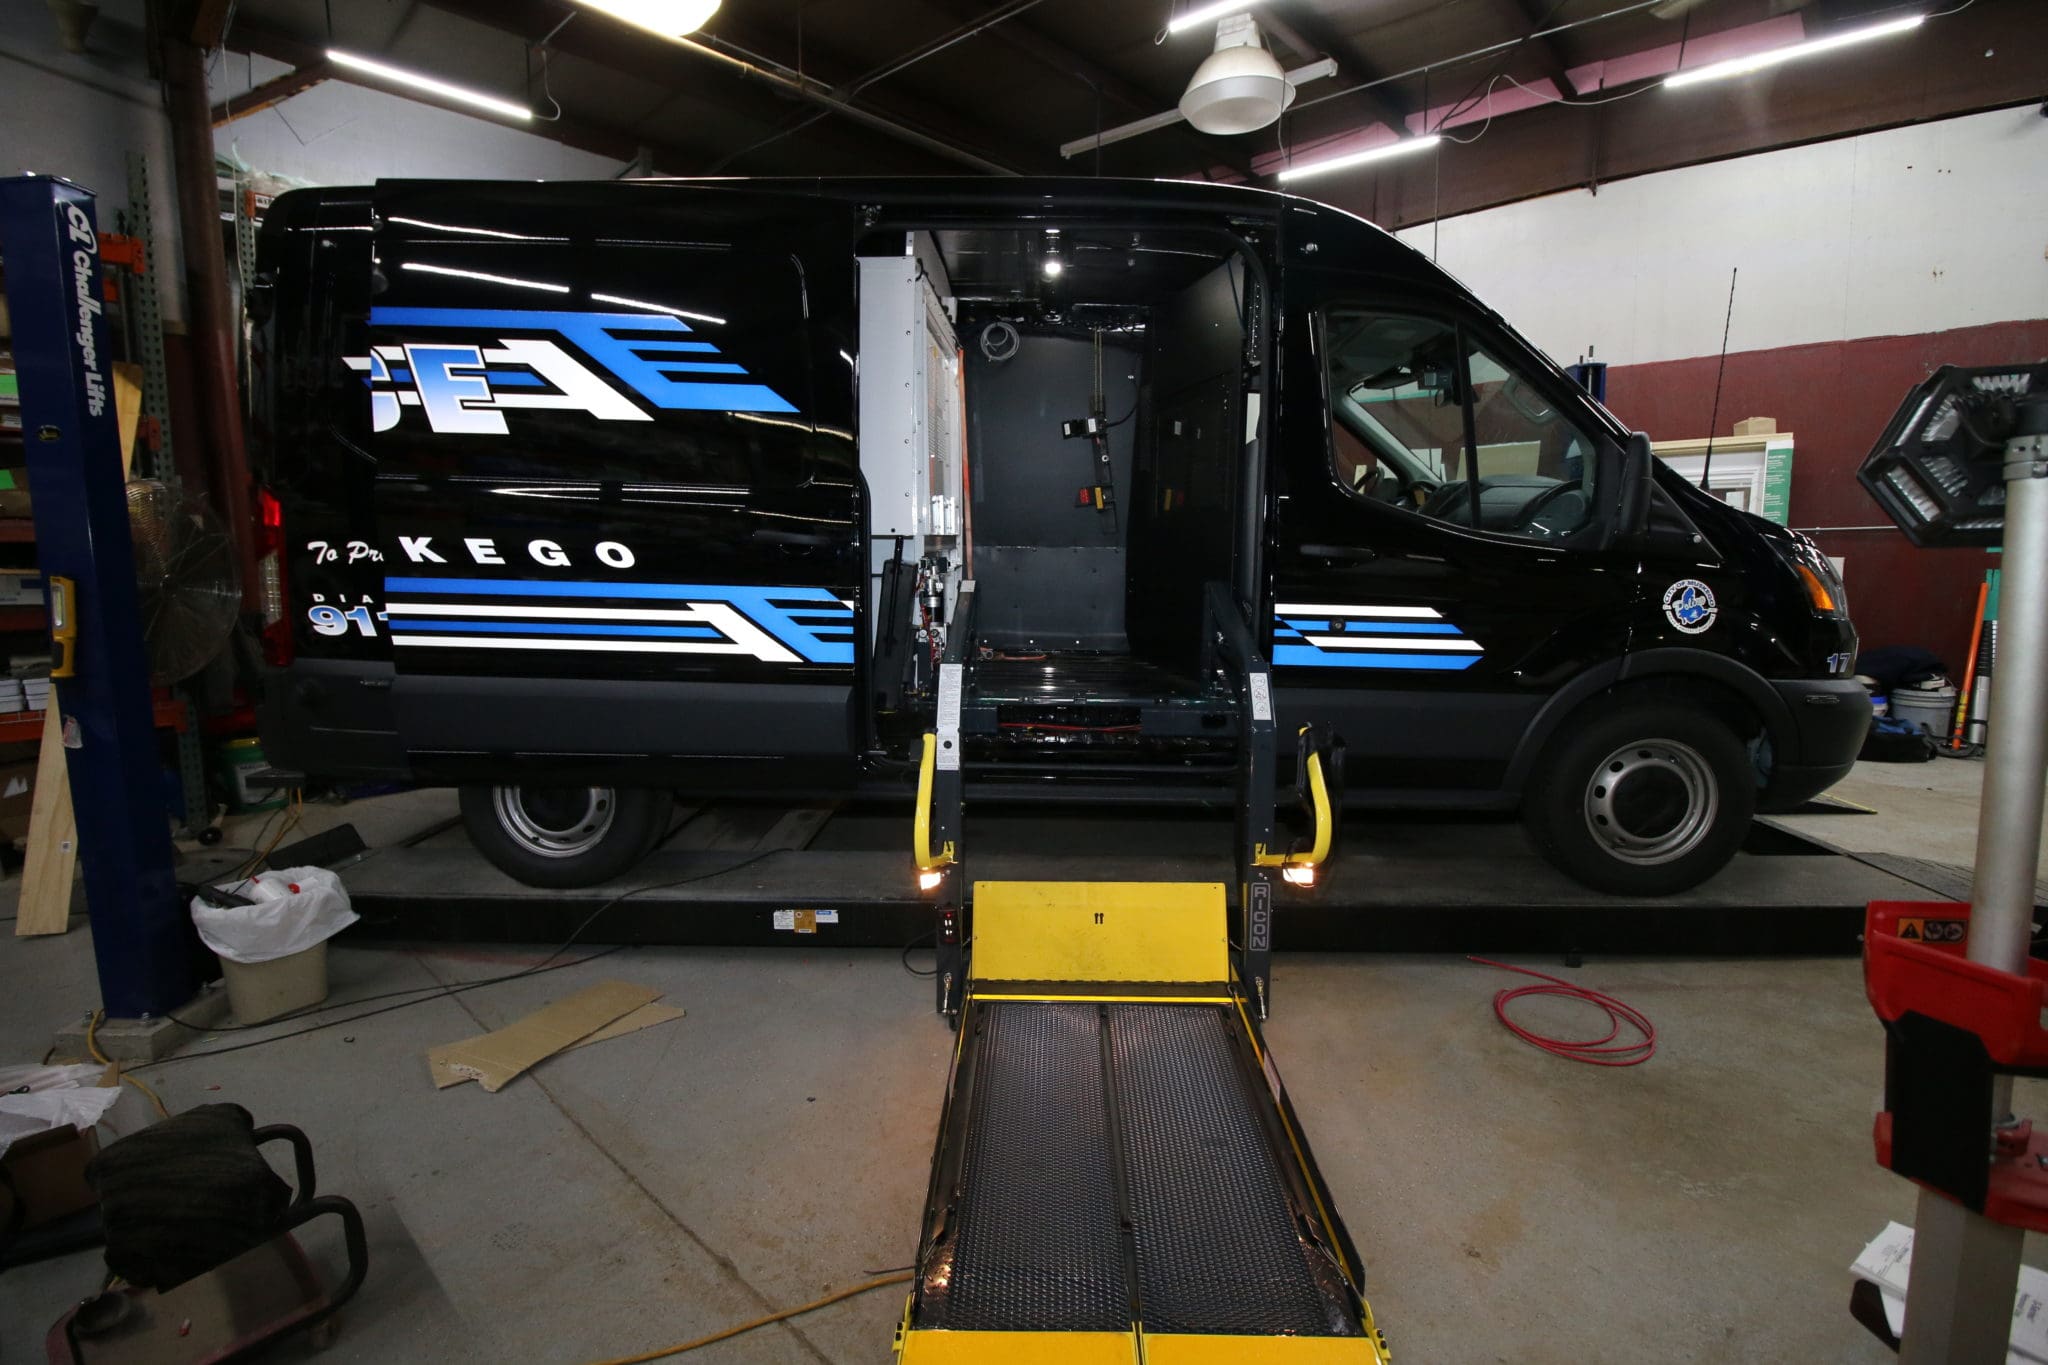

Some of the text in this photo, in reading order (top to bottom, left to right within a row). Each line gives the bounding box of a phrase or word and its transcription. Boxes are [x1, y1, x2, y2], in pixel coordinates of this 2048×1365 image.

[86, 371, 106, 417] Lifts
[307, 541, 338, 565] To
[1664, 585, 1677, 603] CITY
[1687, 580, 1715, 606] MUSKEGO
[1827, 652, 1852, 673] 17
[1253, 886, 1267, 948] RICON
